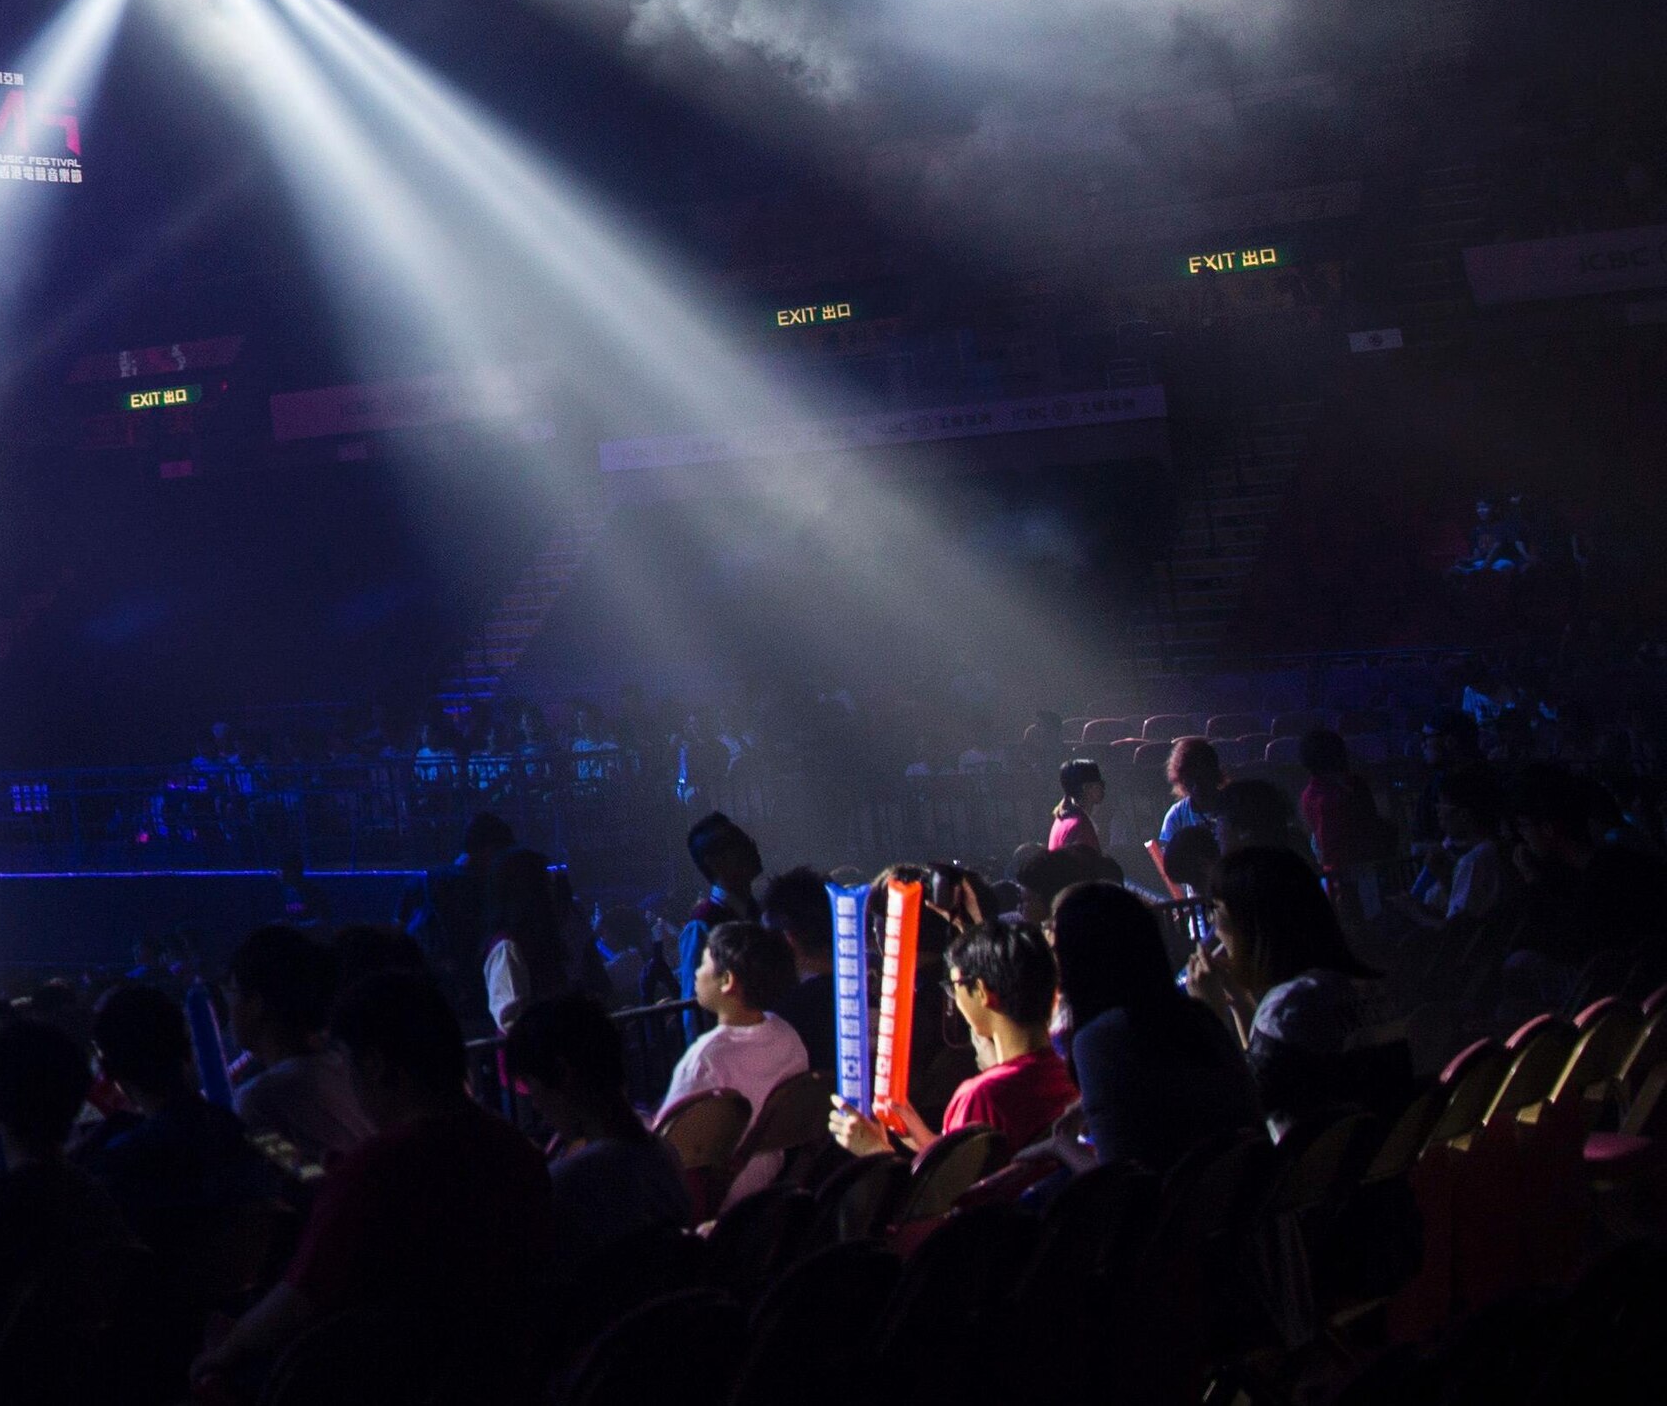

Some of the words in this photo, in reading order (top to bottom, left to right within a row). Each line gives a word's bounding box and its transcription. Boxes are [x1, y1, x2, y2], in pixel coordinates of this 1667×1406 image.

[28, 157, 82, 168] FESTIVAL
[1189, 252, 1236, 274] EXIT
[1242, 248, 1276, 267] 出口
[777, 306, 817, 326] EXIT
[822, 303, 851, 320] 出口
[130, 391, 161, 408] EXIT
[164, 389, 187, 404] 出口
